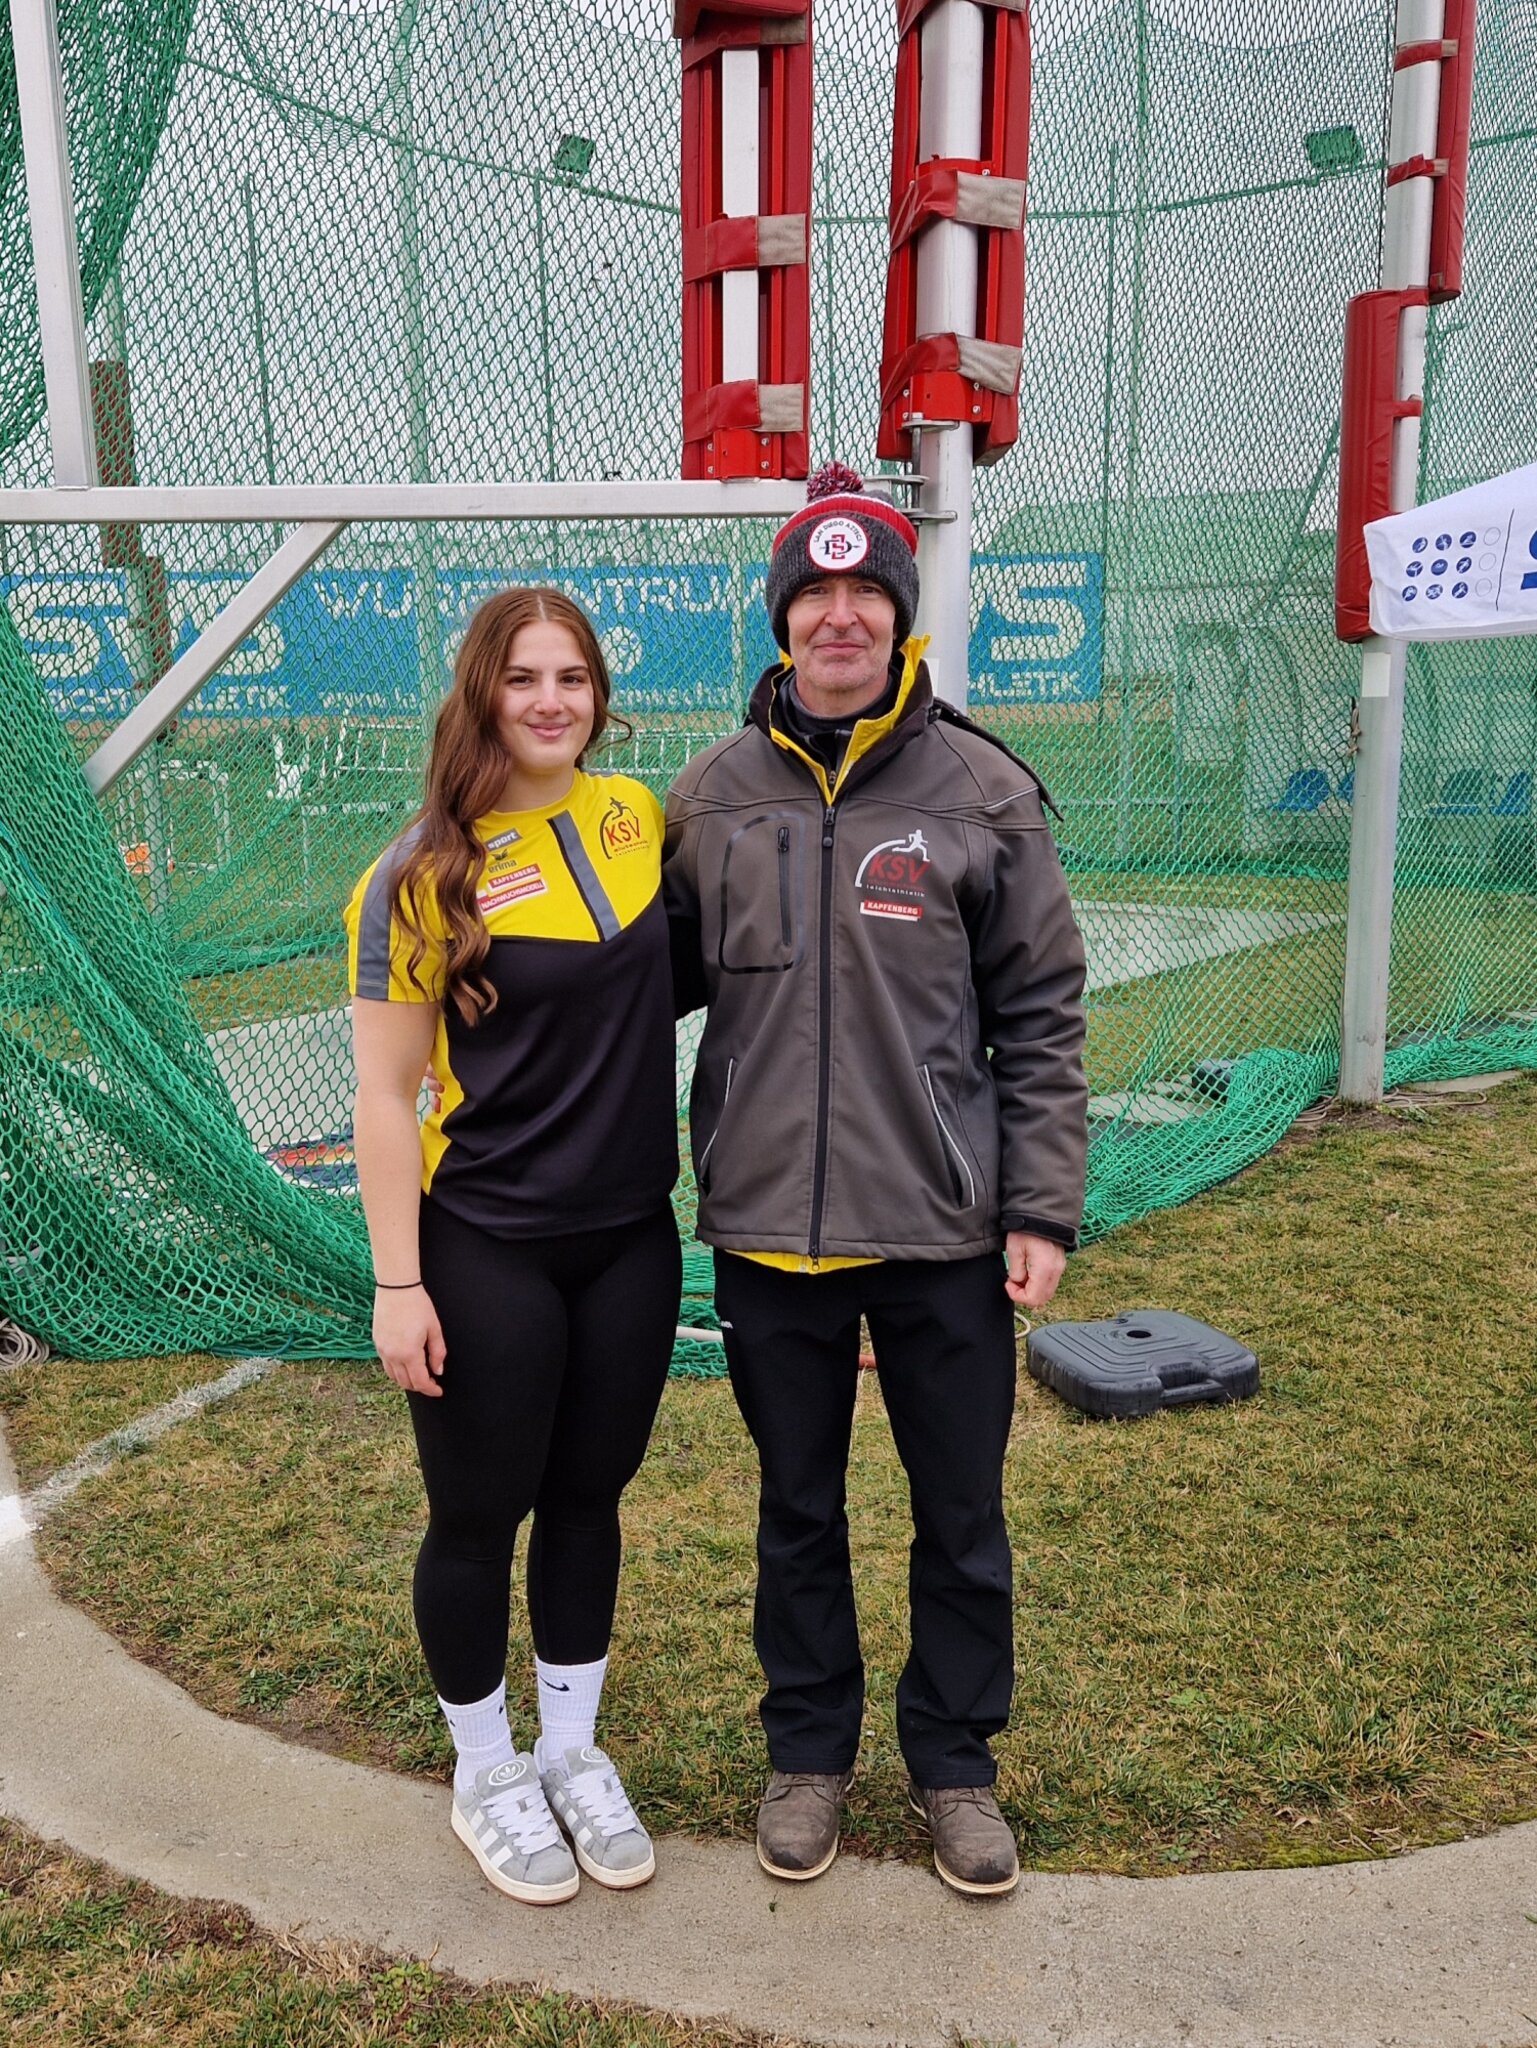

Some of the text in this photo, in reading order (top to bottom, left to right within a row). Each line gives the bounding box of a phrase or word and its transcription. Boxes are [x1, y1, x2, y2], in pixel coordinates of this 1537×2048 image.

[823, 520, 844, 530] DIEGO
[487, 831, 518, 850] sport
[604, 819, 640, 847] KSV
[488, 860, 517, 873] erima
[492, 866, 537, 886] KAPFENBERG
[867, 853, 930, 883] KSV
[867, 901, 919, 915] KAPFENBERG
